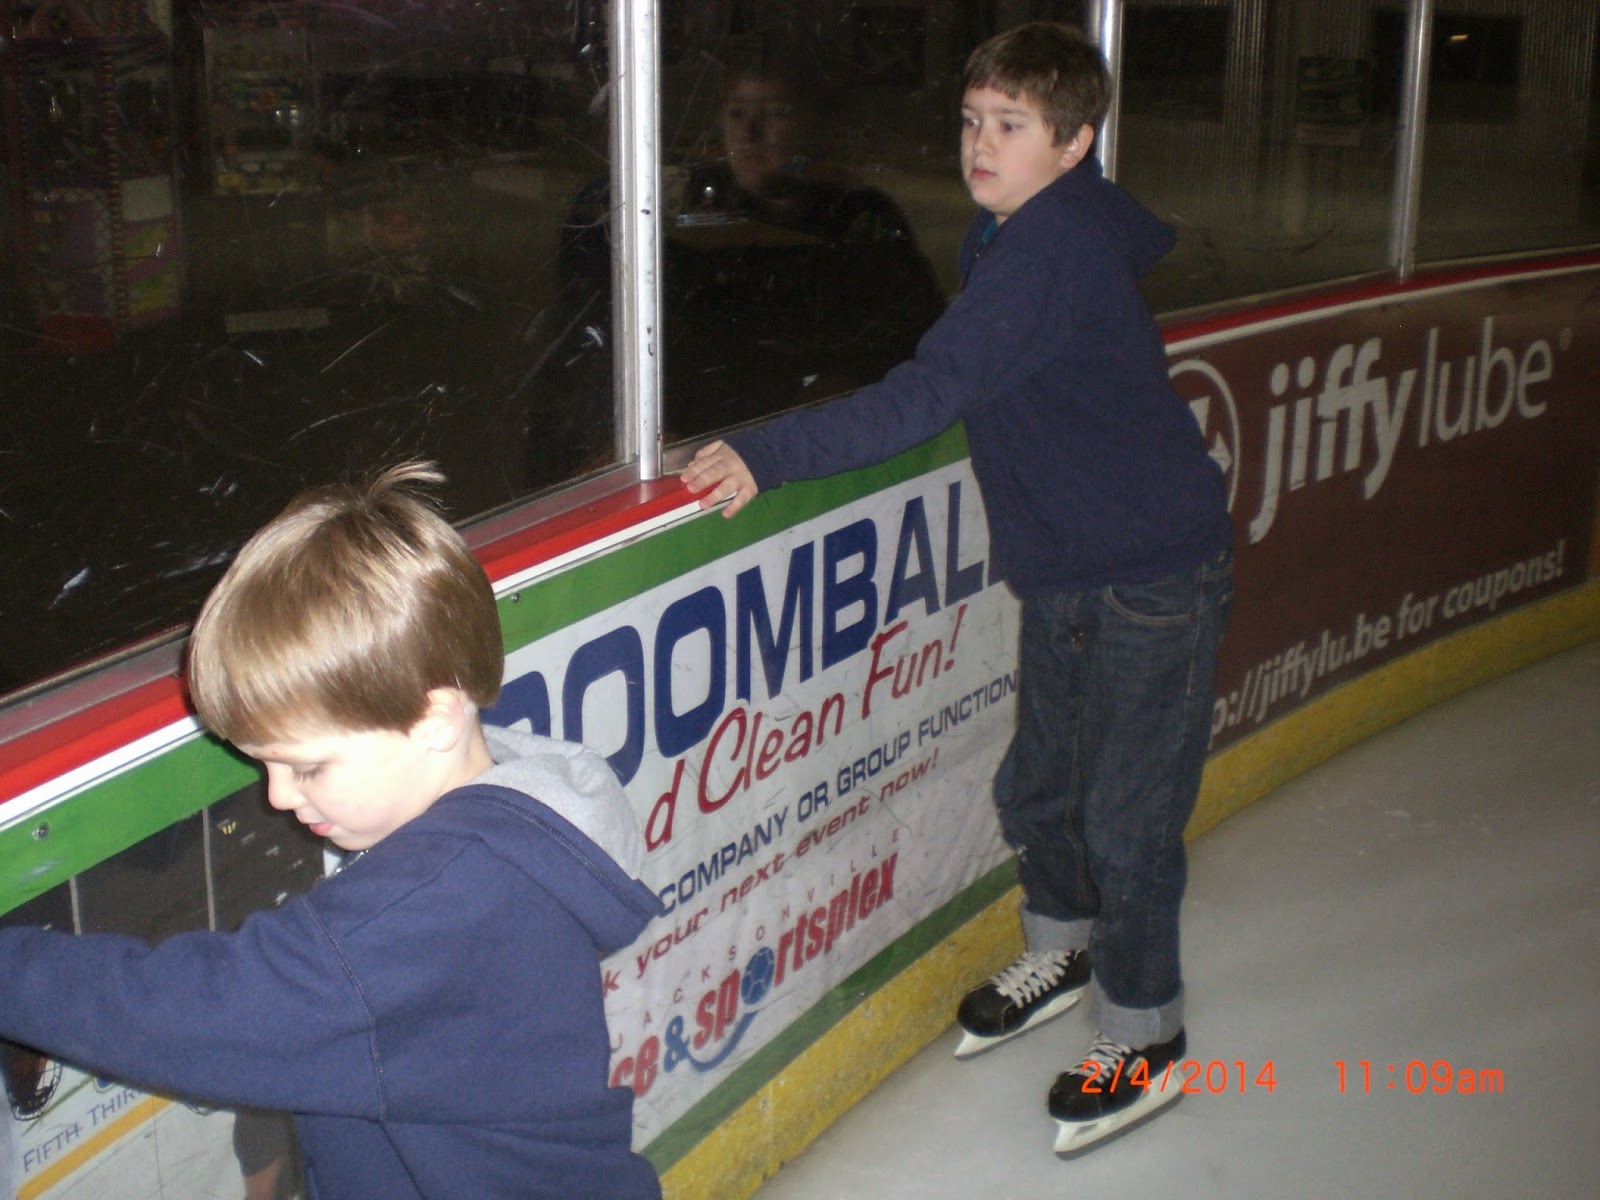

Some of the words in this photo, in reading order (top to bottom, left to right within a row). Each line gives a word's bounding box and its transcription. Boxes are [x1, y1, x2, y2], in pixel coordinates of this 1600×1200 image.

[1248, 337, 1419, 546] jiffy
[1418, 315, 1553, 448] lube
[480, 480, 1004, 788] OOMBAL
[1396, 592, 1440, 639] for
[1441, 539, 1566, 618] coupons!
[697, 692, 845, 815] Clean
[861, 603, 968, 720] Fun!
[636, 907, 709, 980] your
[720, 852, 786, 912] next
[795, 795, 870, 858] event
[880, 747, 939, 802] now!
[656, 806, 789, 918] COMPANY
[797, 781, 830, 823] OR
[837, 730, 911, 797] GROUP
[22, 1121, 82, 1173] FIFTH
[87, 1085, 143, 1127] THIR
